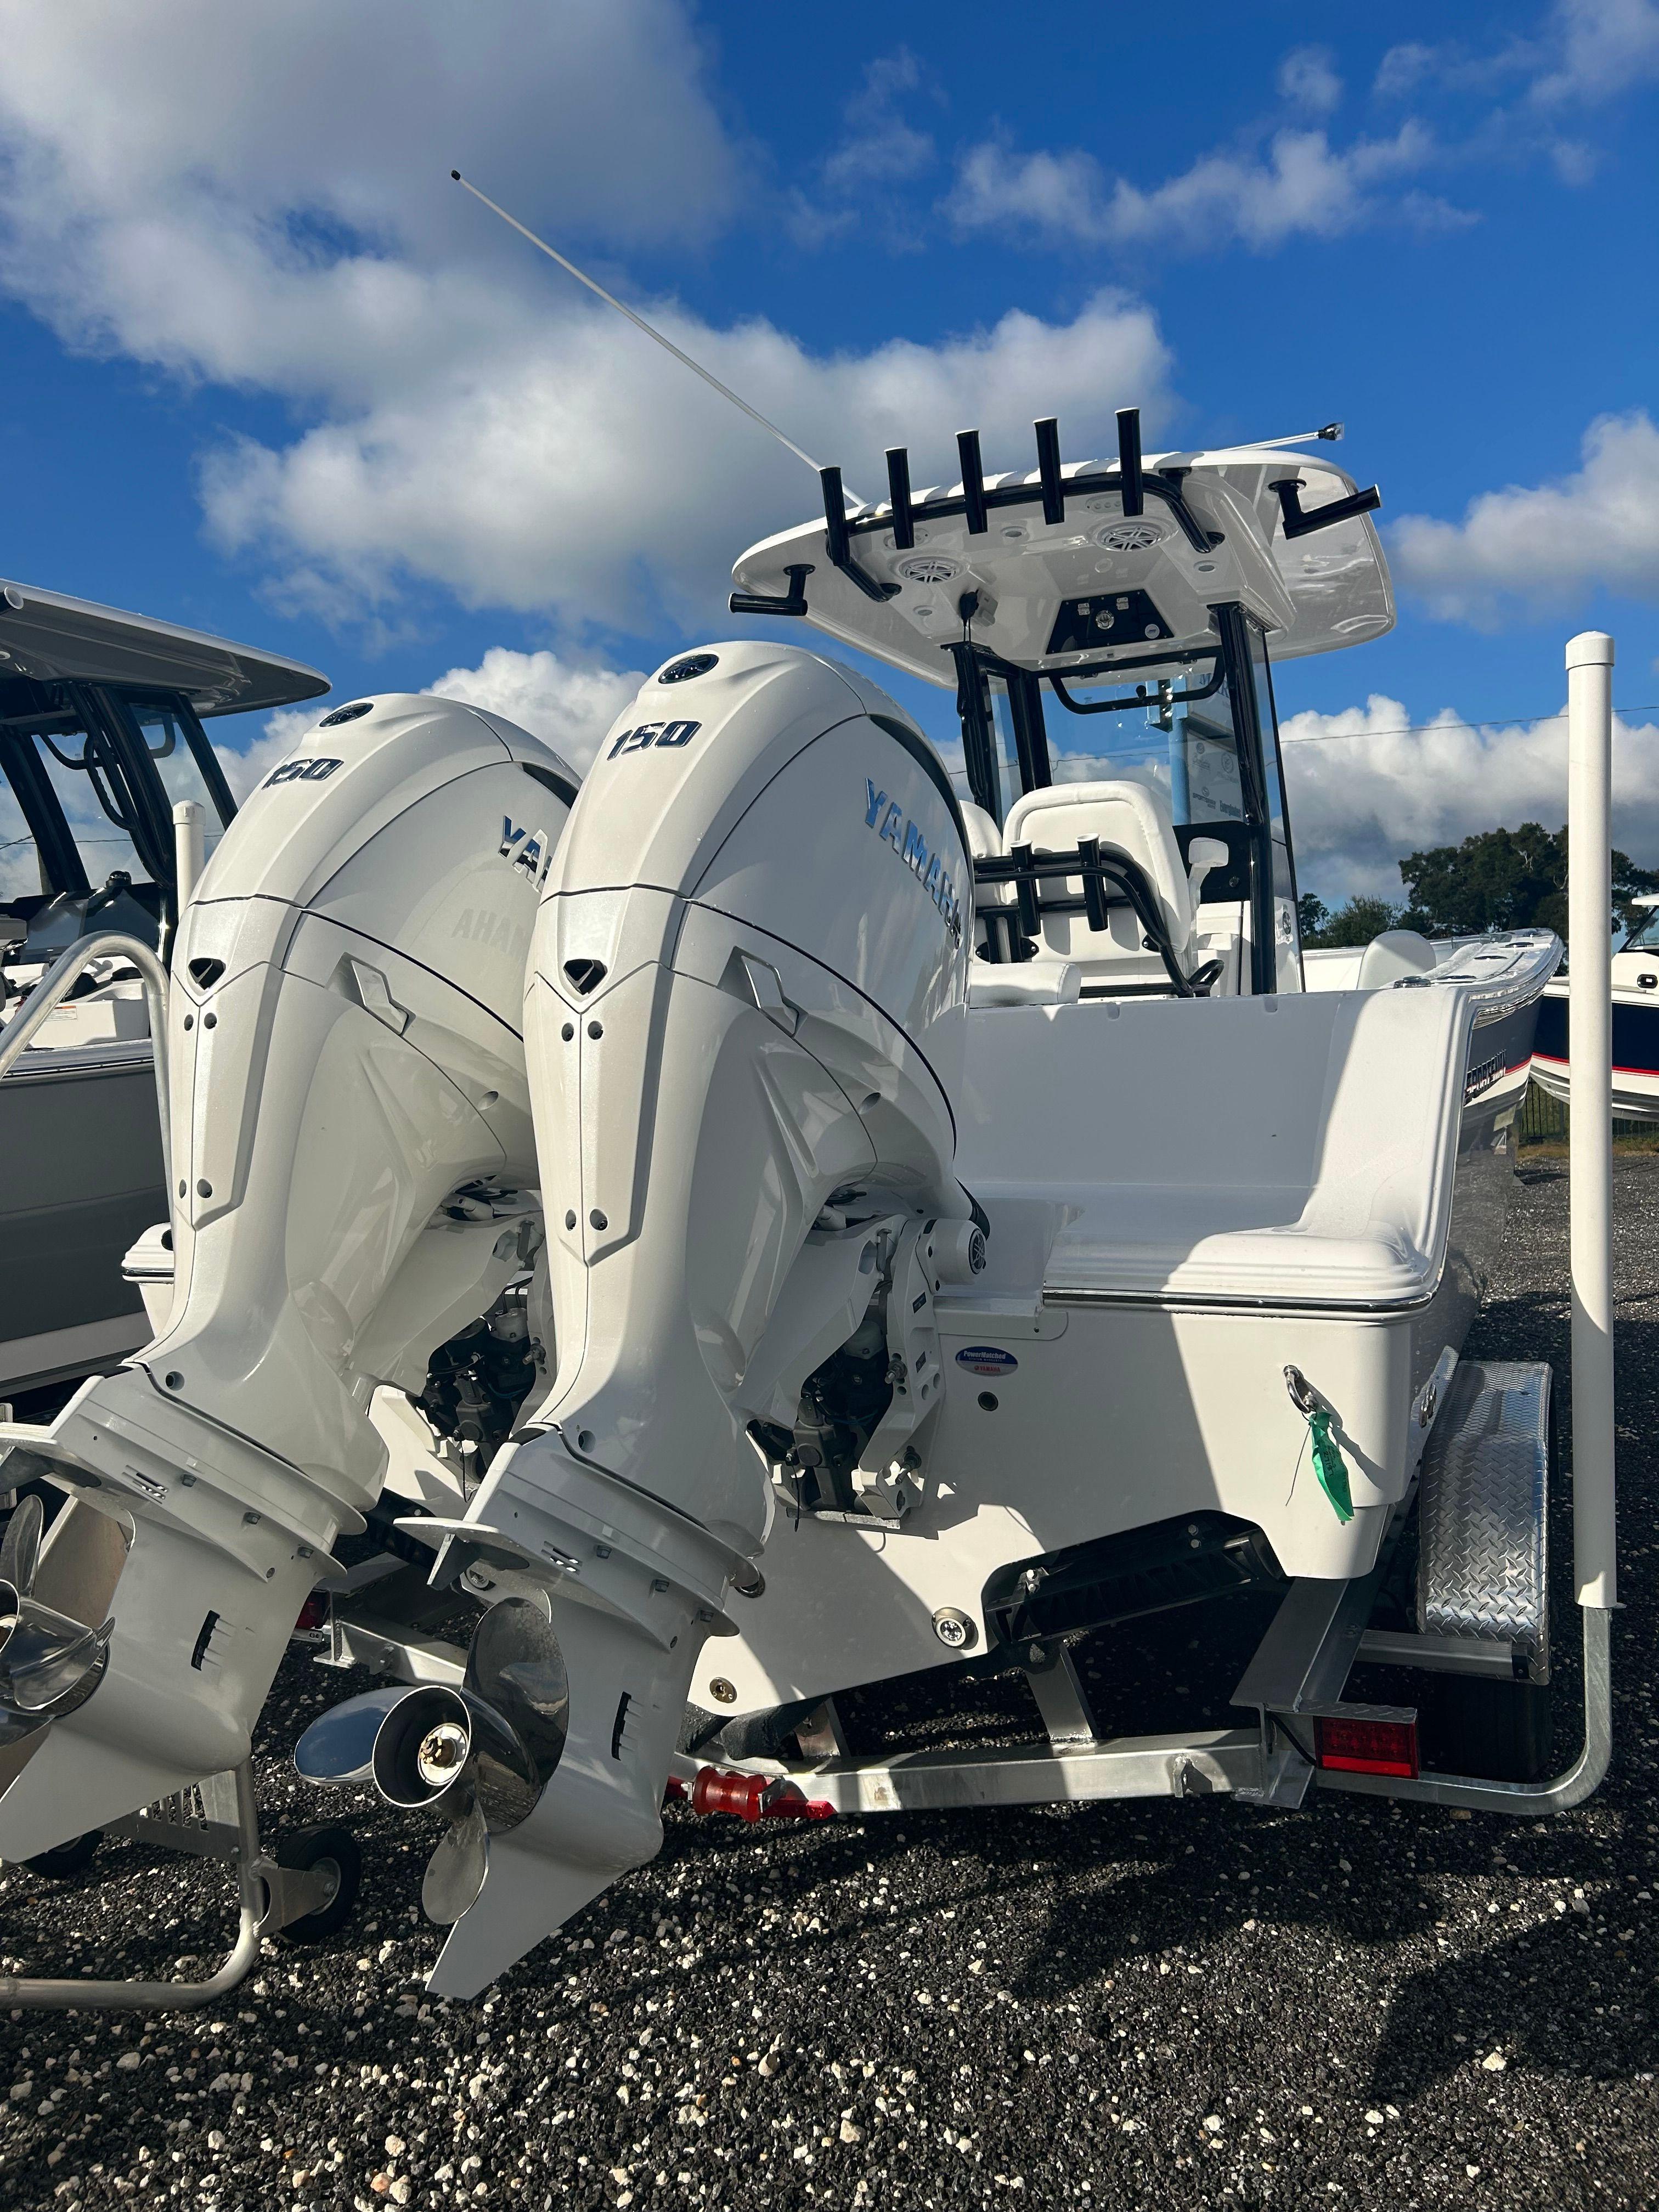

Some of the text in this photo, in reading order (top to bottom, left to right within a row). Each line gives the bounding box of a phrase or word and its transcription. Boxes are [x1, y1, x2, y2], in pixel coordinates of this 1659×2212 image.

[607, 721, 702, 761] 150
[261, 758, 345, 791] 150
[865, 777, 962, 949] YAMAHA
[963, 1350, 1006, 1359] PowerMatched
